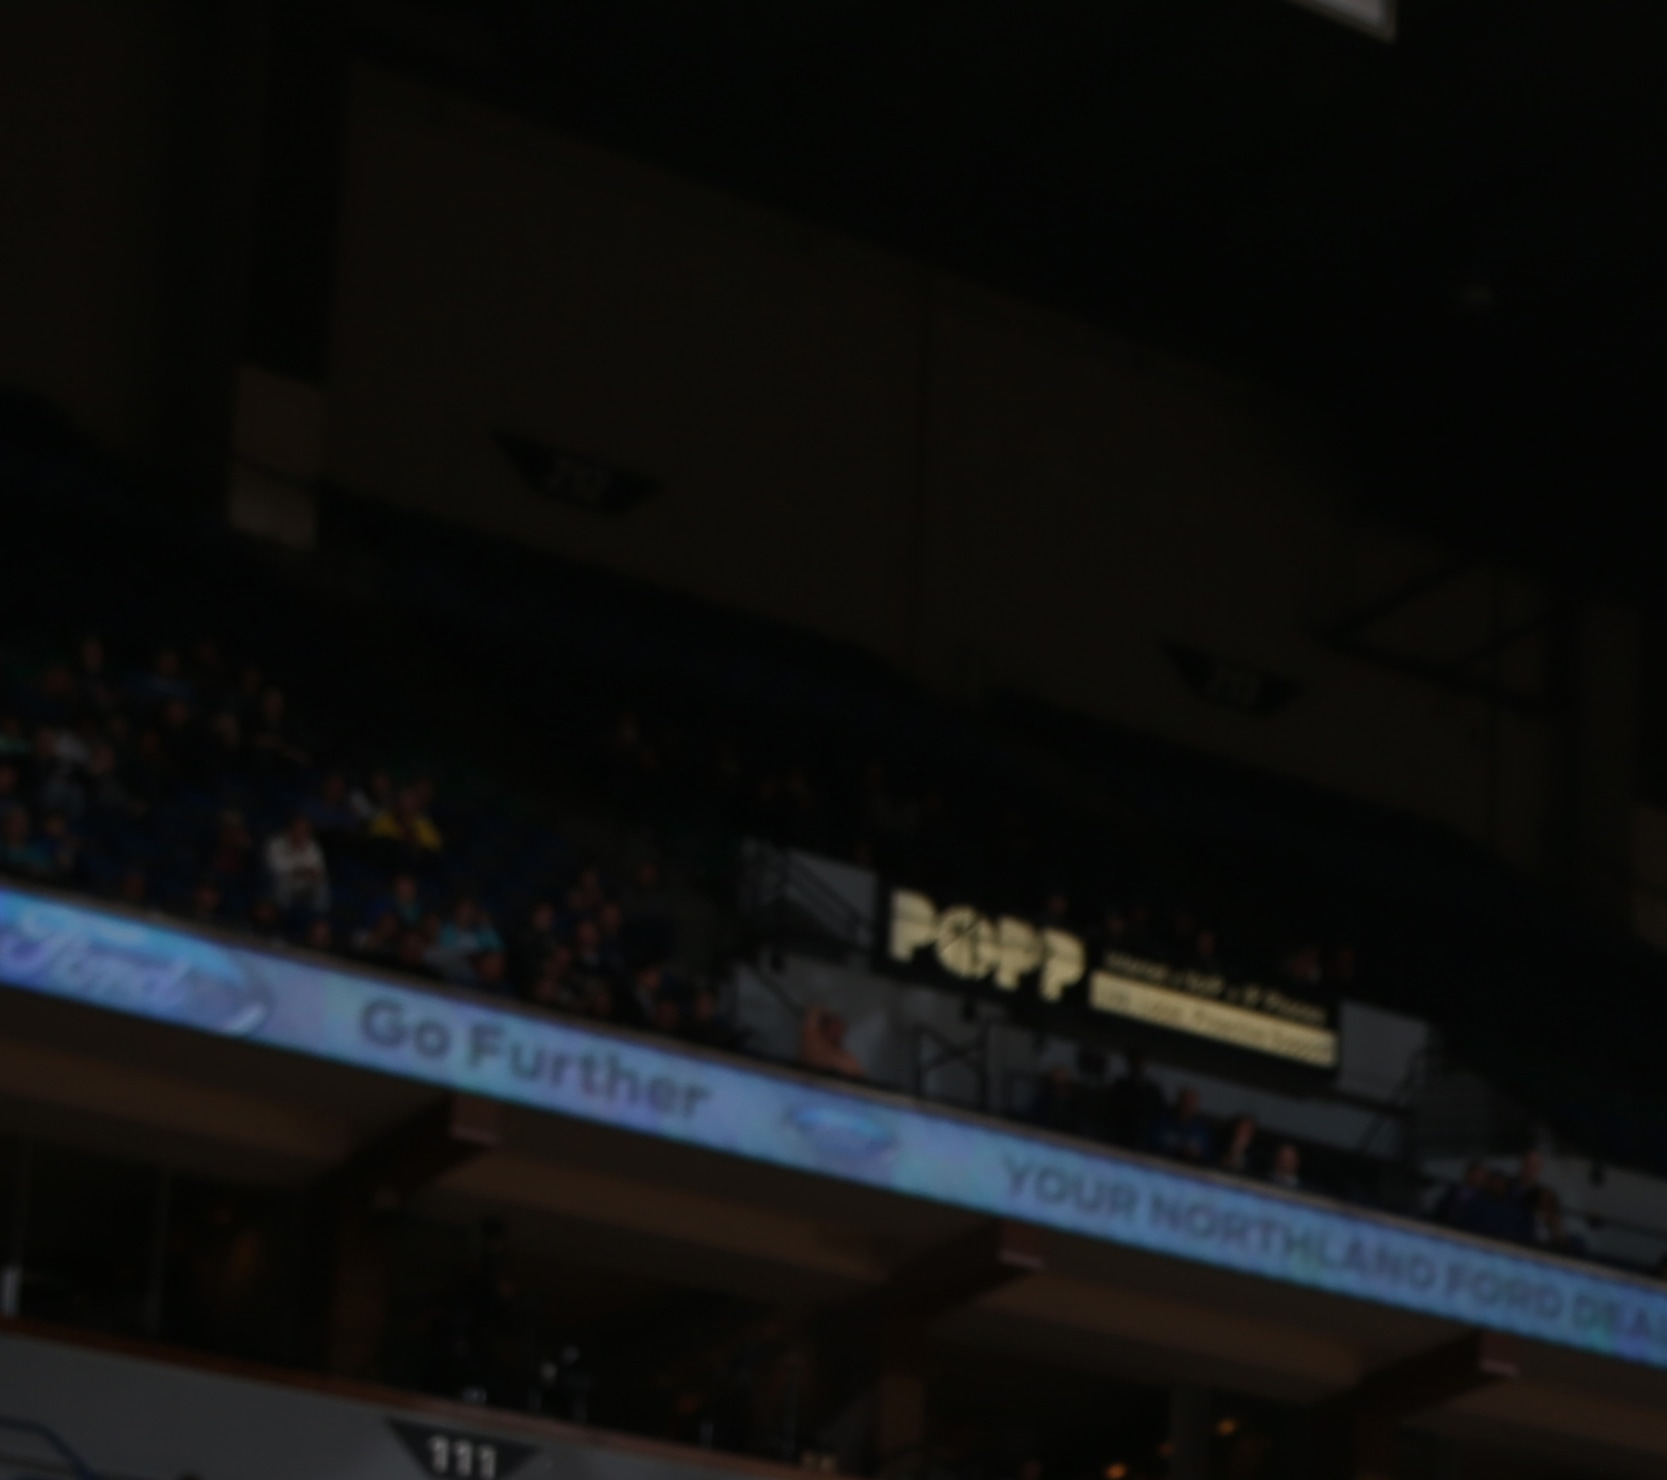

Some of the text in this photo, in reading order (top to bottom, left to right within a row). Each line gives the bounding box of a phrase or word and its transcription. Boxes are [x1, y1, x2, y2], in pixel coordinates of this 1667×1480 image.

[888, 887, 1087, 1003] POPP
[359, 998, 713, 1120] Go Further
[1002, 1156, 1140, 1218] YOUR
[1149, 1192, 1434, 1292] NORTHLAND
[1443, 1262, 1562, 1322] FORD
